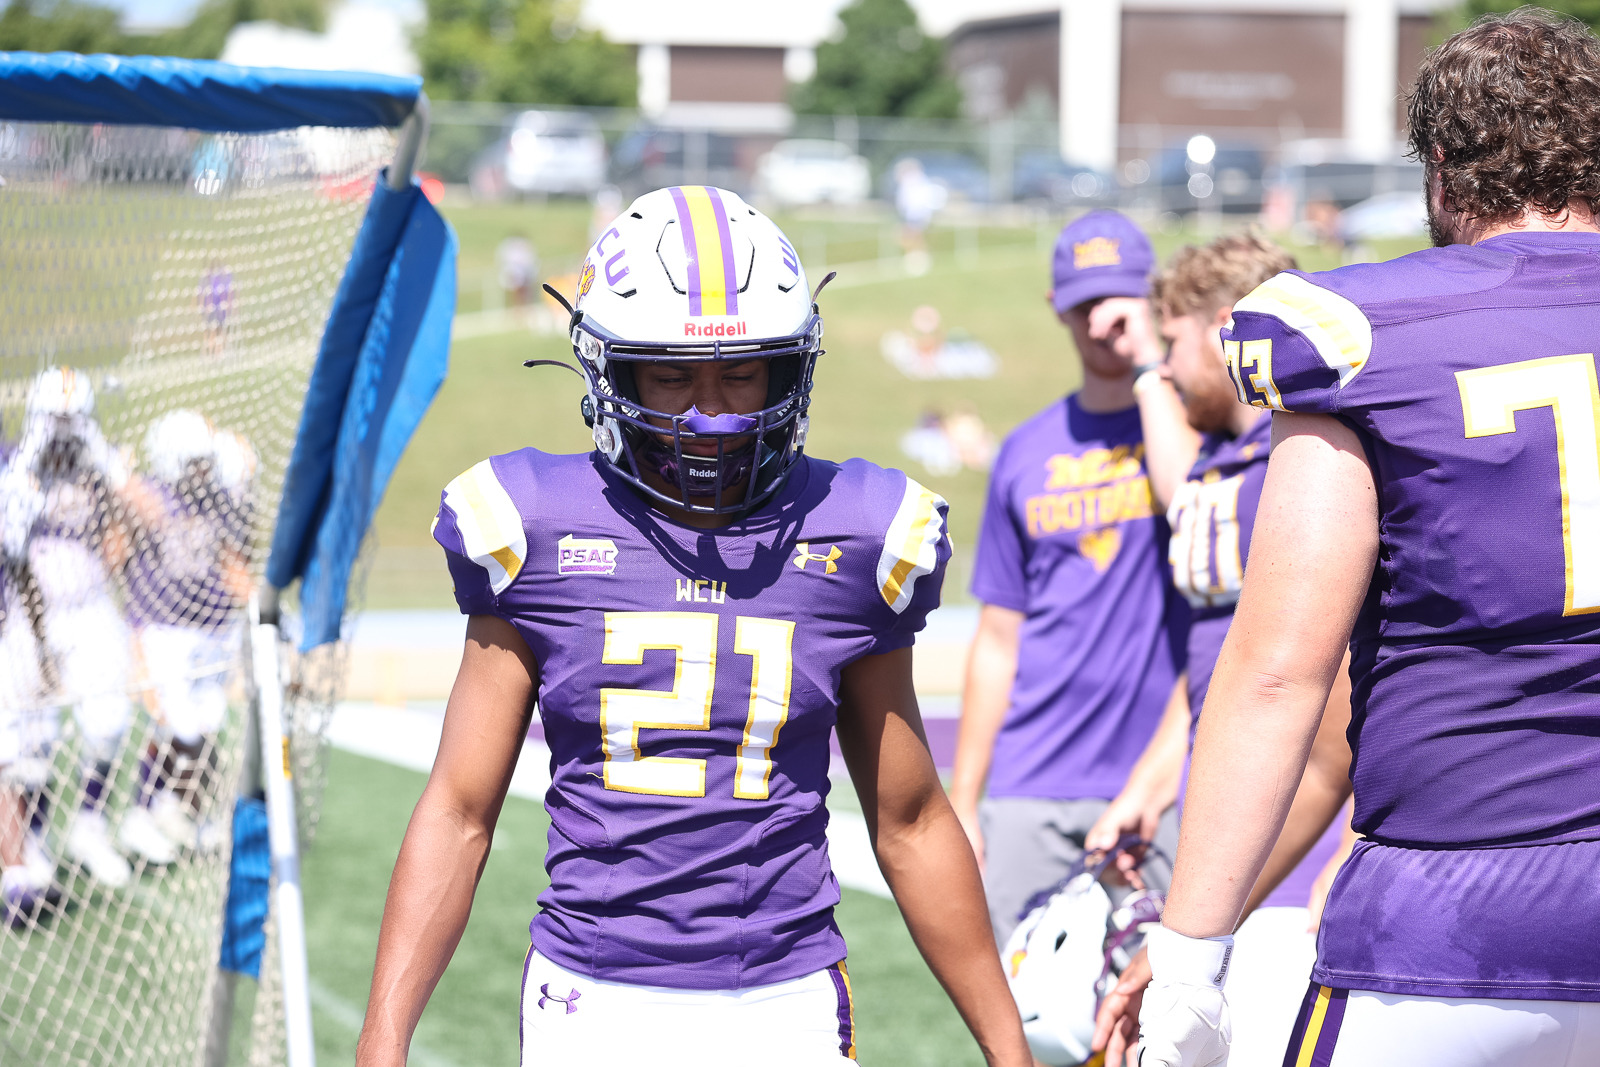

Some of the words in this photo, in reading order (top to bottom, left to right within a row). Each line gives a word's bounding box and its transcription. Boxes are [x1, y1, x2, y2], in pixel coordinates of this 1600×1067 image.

[593, 227, 630, 287] CU
[684, 320, 747, 337] Riddell
[1224, 338, 1294, 413] 73
[689, 468, 718, 478] Riddel
[560, 549, 614, 564] PSAC
[675, 578, 727, 604] WCU
[600, 611, 796, 800] 21
